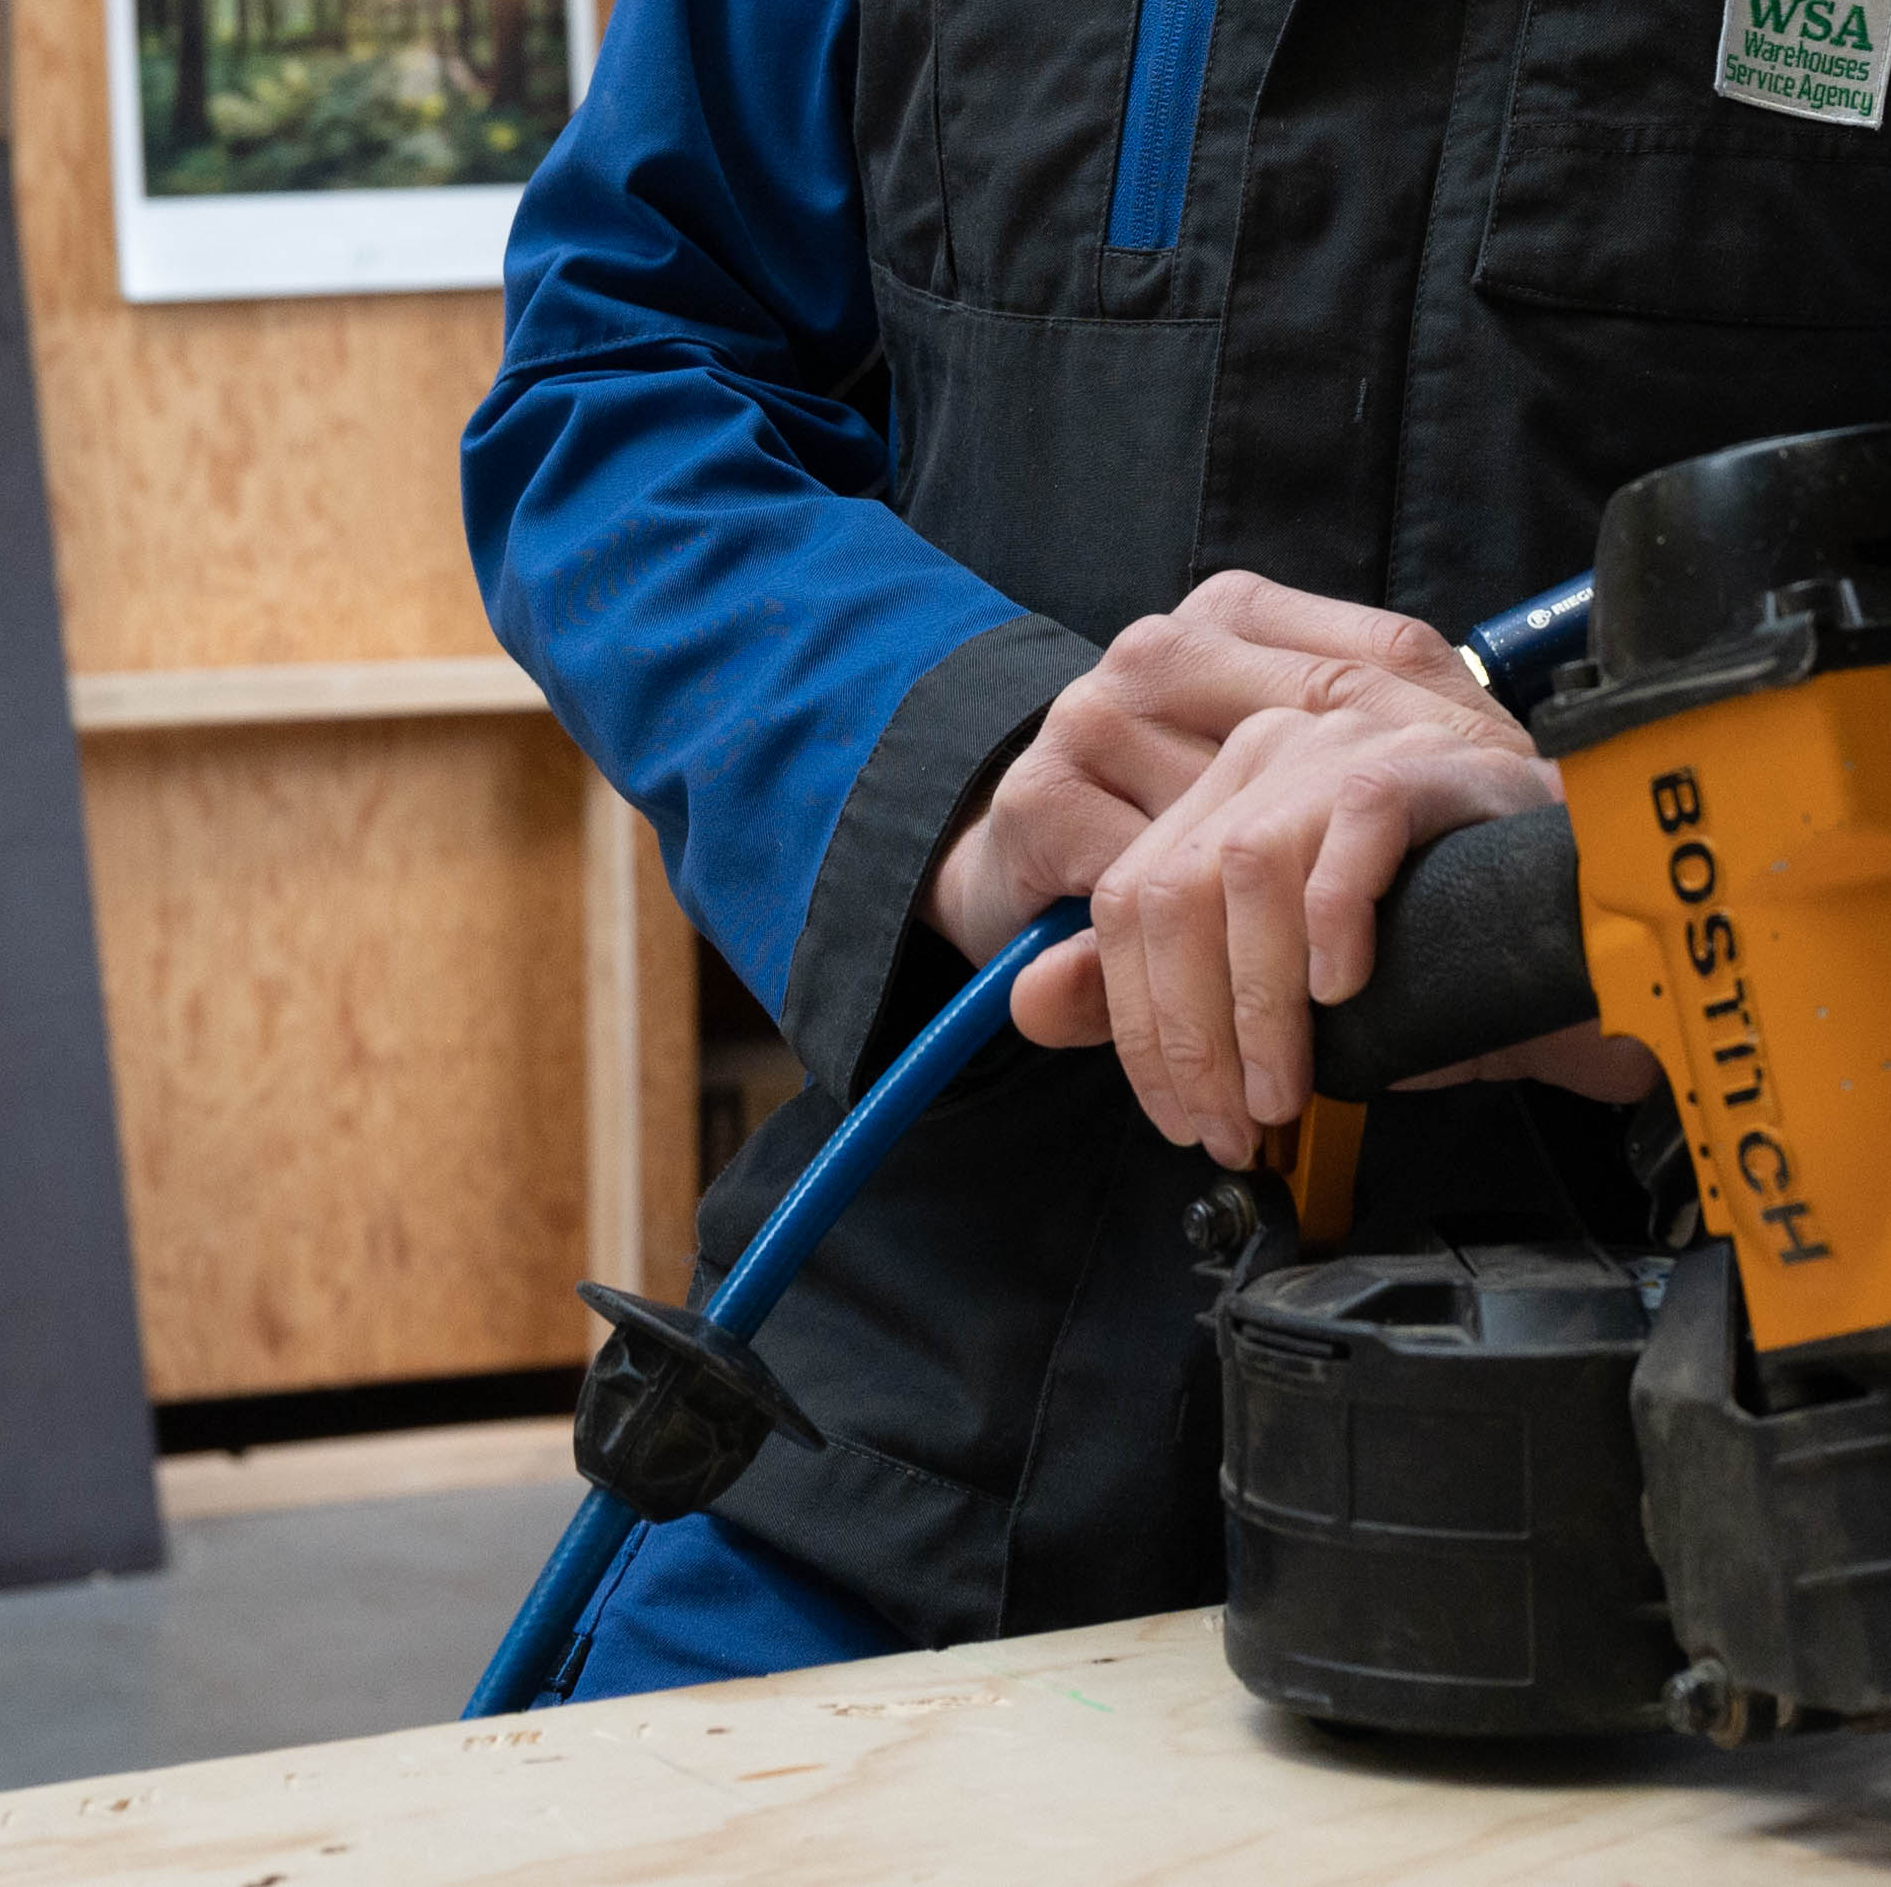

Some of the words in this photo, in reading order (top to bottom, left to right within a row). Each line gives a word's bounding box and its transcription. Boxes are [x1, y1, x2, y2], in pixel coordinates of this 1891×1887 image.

[1725, 54, 1796, 98] Service
[1797, 73, 1874, 116] Agency
[1744, 29, 1870, 81] Warehouses
[1648, 764, 1831, 1266] BOSTITCH
